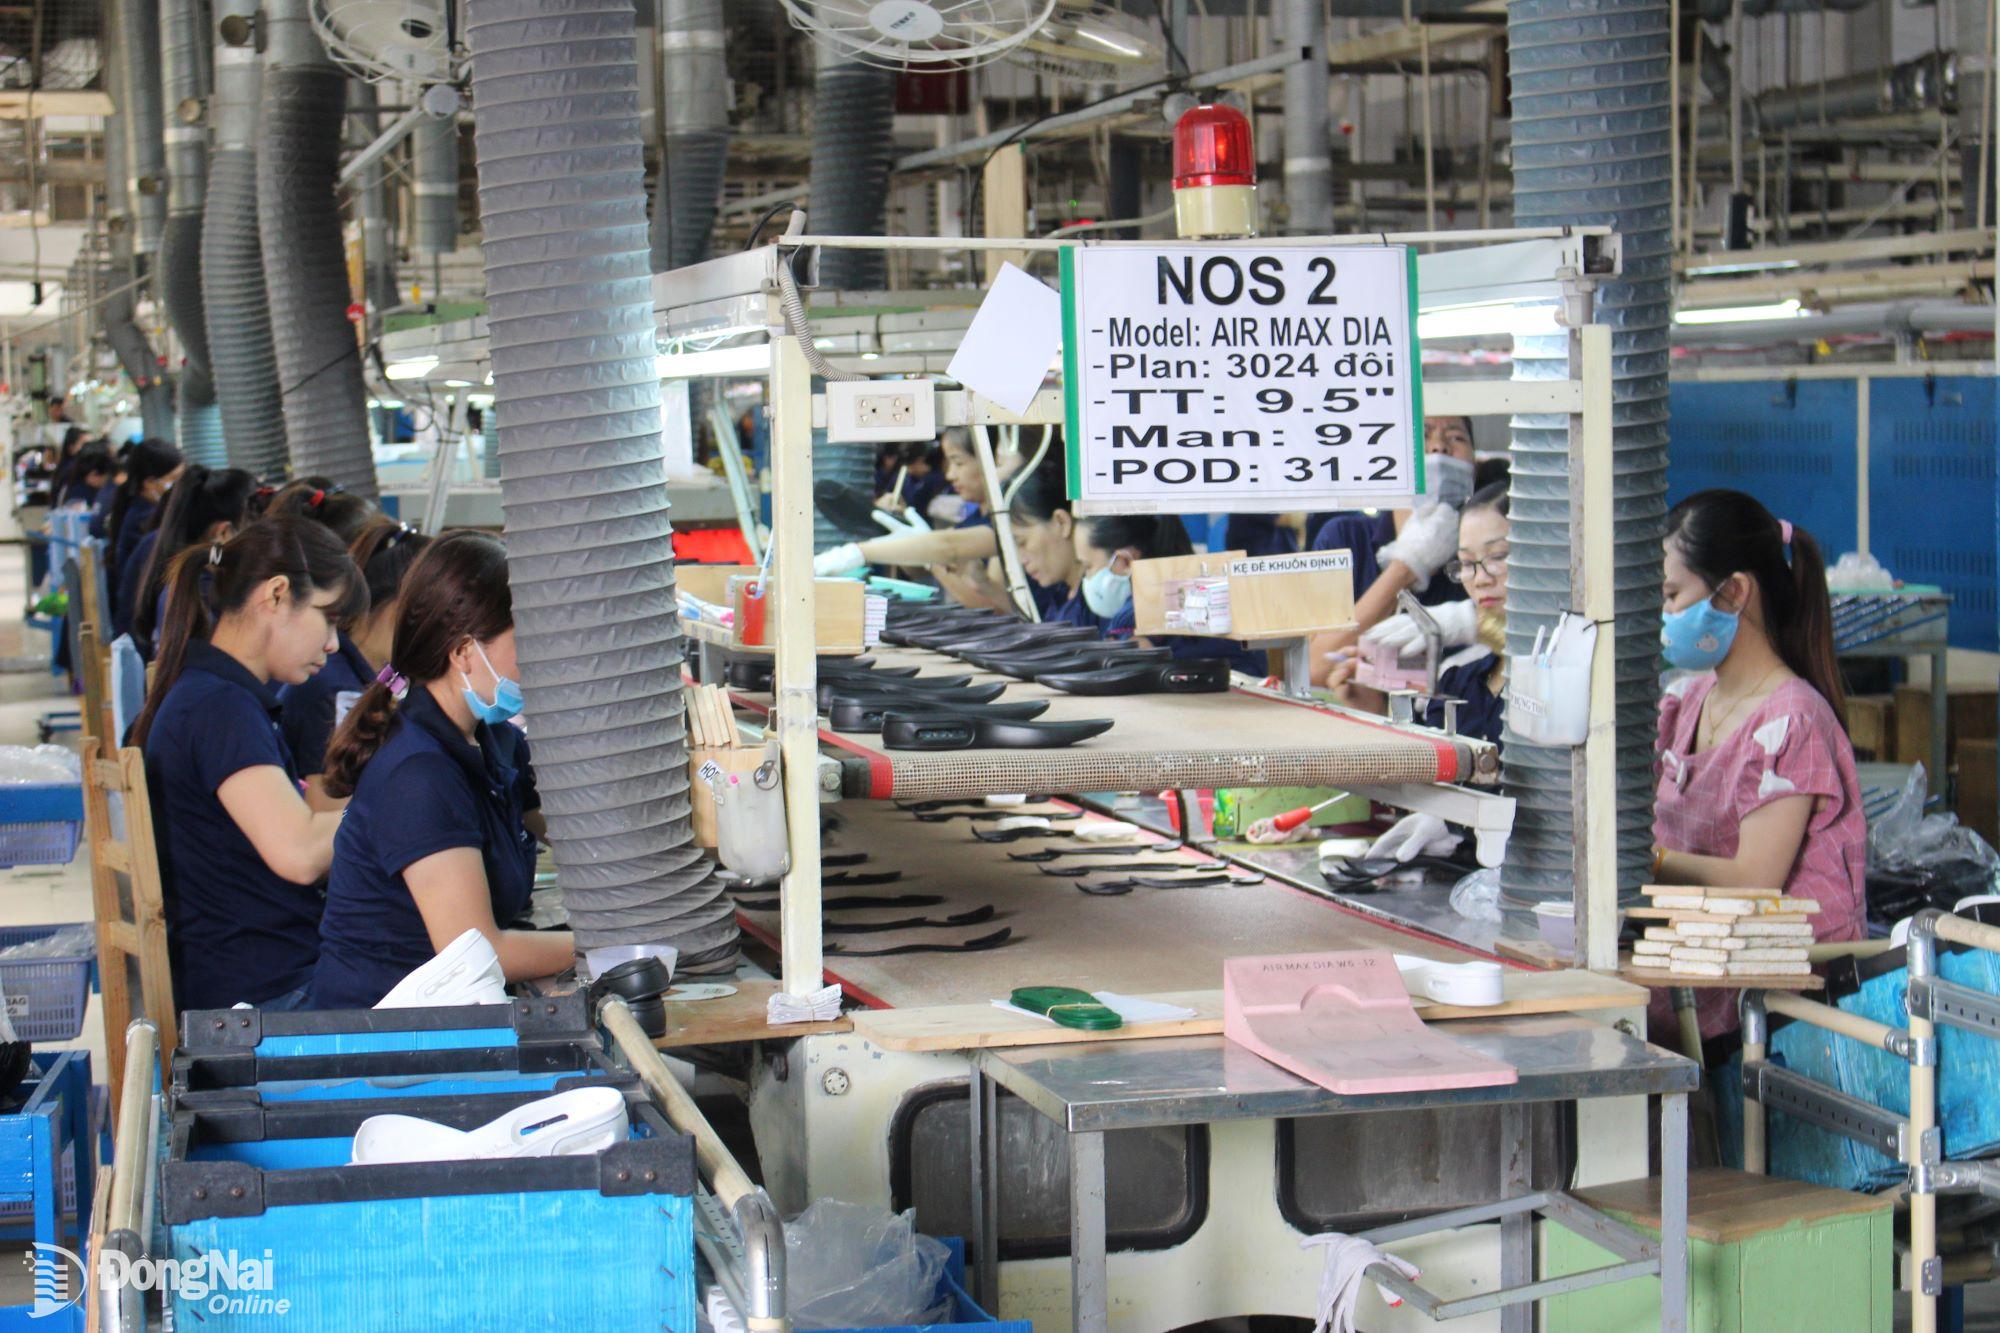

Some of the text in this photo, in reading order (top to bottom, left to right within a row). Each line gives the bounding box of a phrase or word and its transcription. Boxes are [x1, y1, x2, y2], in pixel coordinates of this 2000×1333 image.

[1156, 255, 1338, 306] NOS 2
[1091, 315, 1393, 348] -Model: AIR MAX DIA
[1093, 351, 1395, 379] -Plan: 3024 đôi
[1094, 388, 1226, 415] -TT:
[1095, 422, 1397, 449] -Man: 97
[1095, 456, 1399, 485] -POD: 31.2
[1268, 557, 1308, 571] KHUÔN
